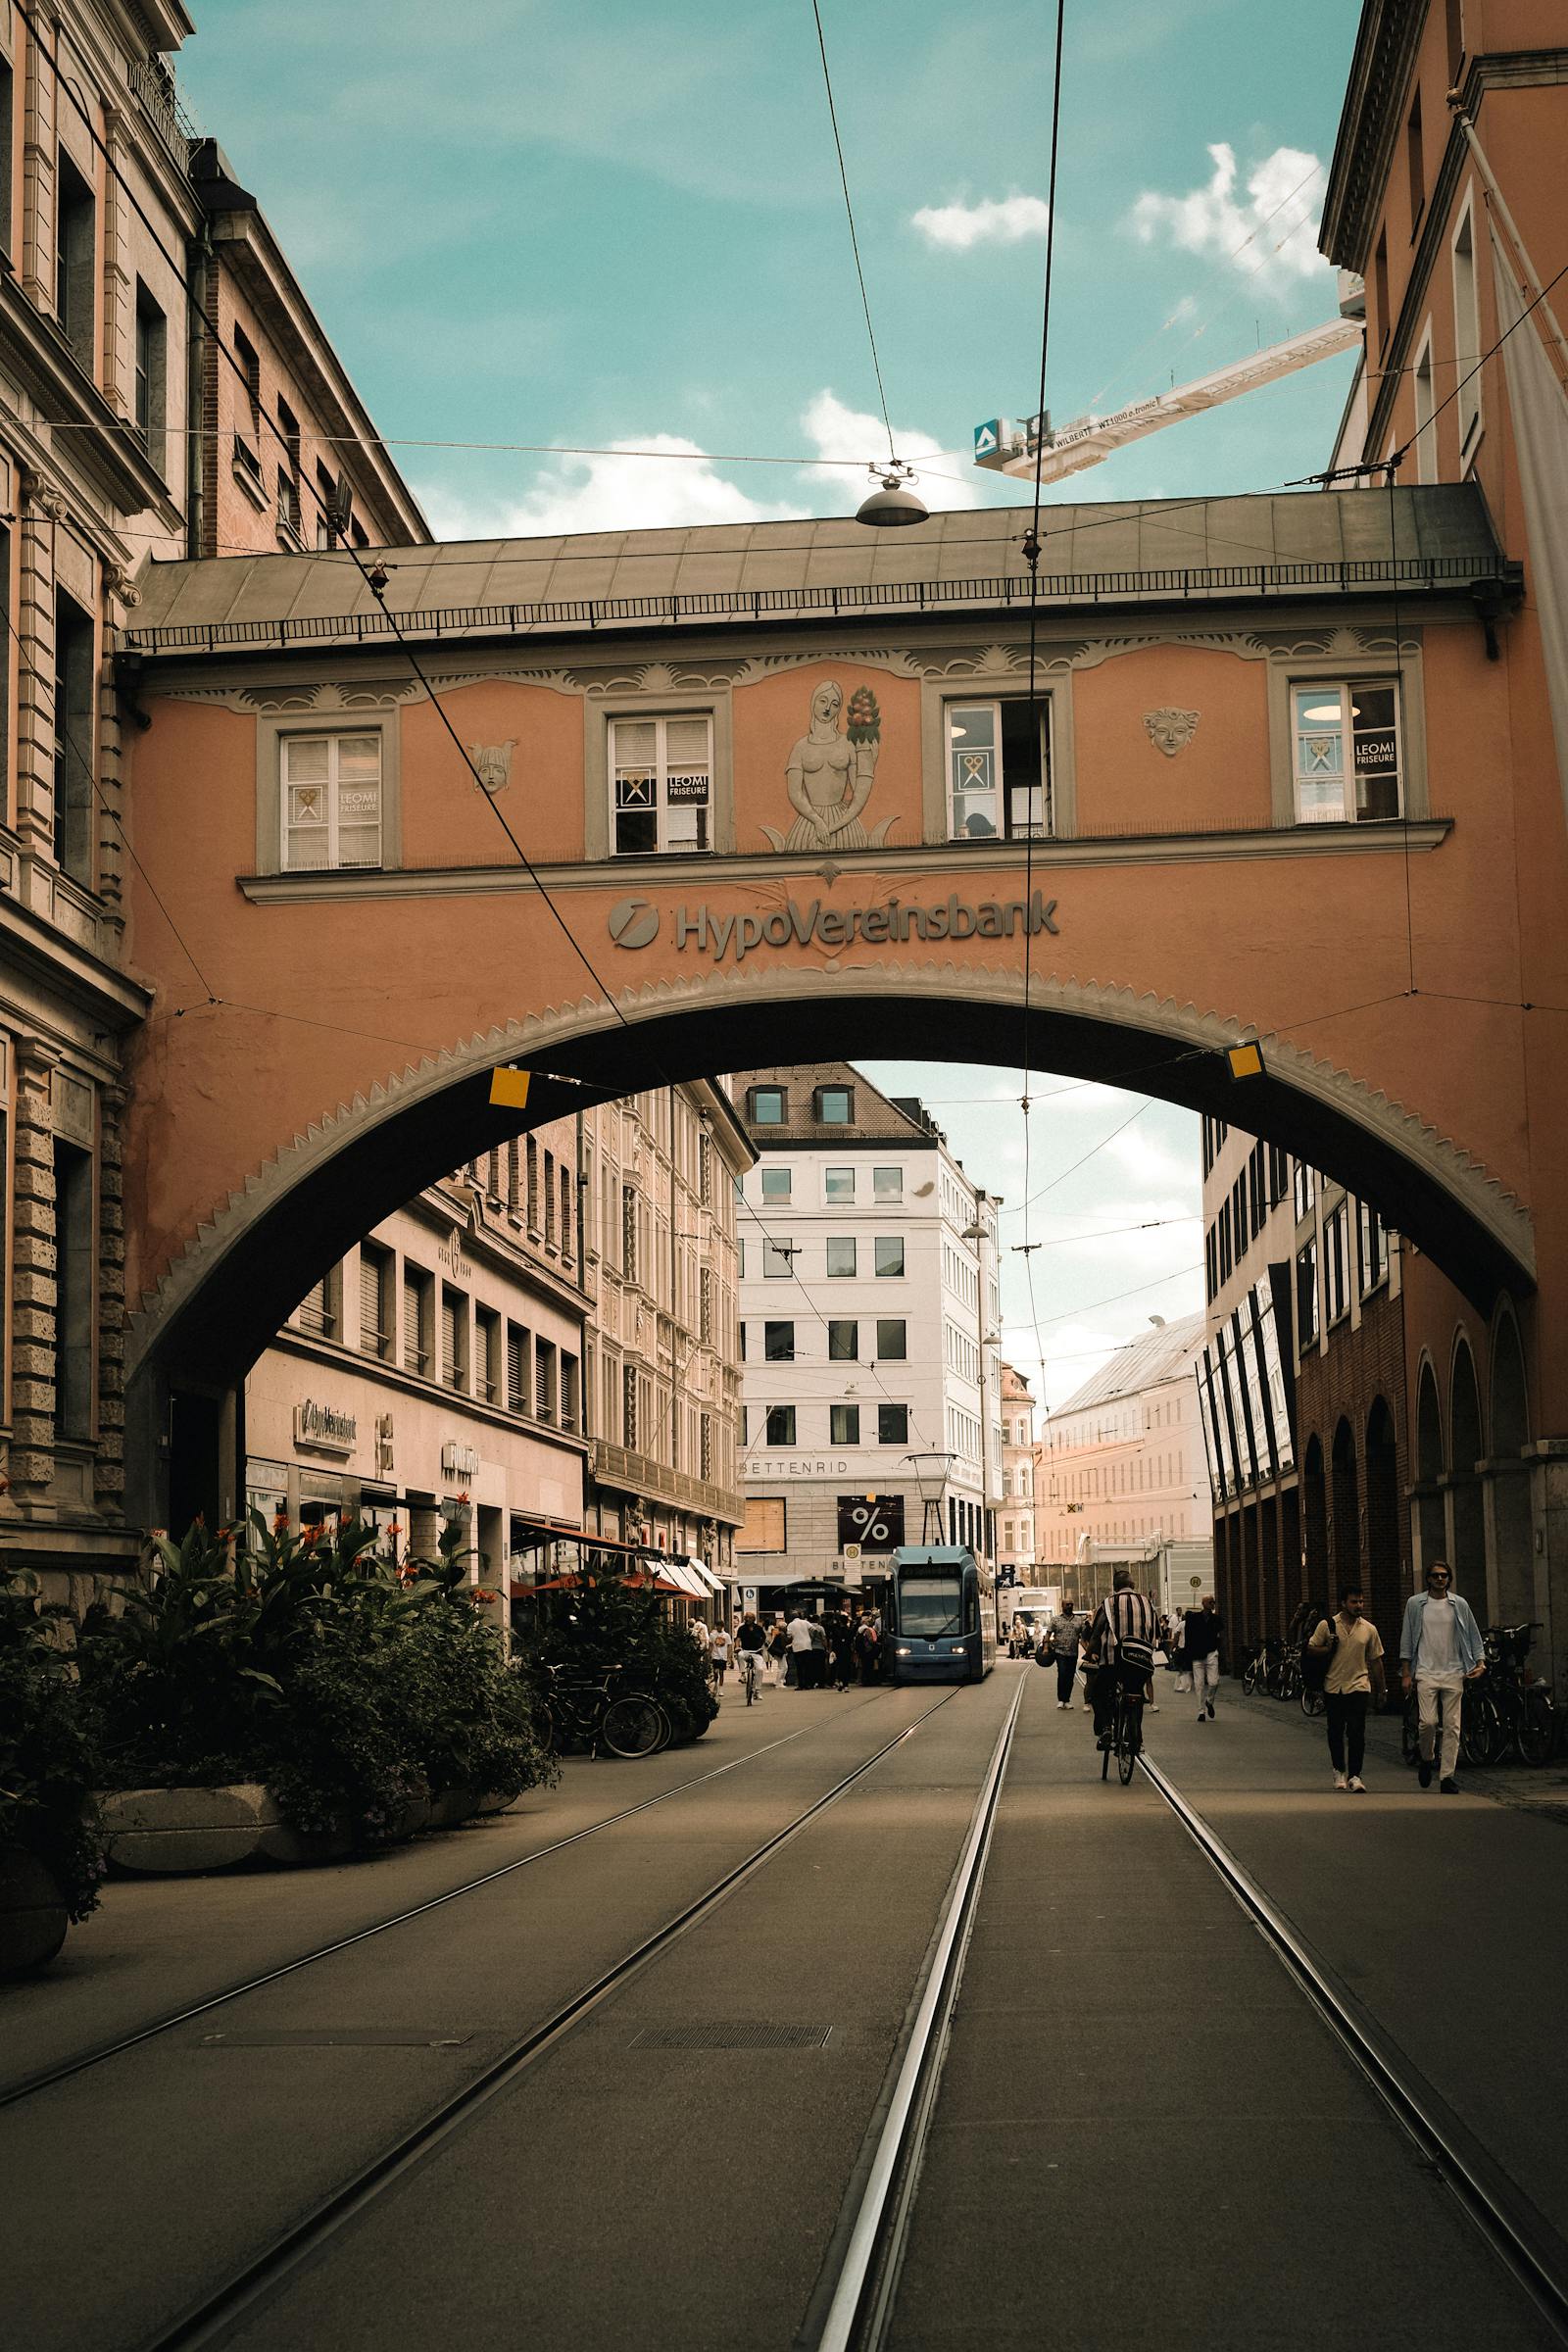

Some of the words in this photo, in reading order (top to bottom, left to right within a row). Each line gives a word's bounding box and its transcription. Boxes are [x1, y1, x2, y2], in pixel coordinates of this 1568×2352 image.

[1055, 428, 1090, 448] WILBERT
[1356, 742, 1395, 756] LEOMI
[1356, 753, 1395, 764] FRISEURE
[669, 775, 707, 787] LEOMI
[669, 786, 708, 796] FRISEURE
[340, 792, 376, 804] LEOMI
[340, 804, 377, 812] FRISEURE
[676, 889, 1060, 961] HypoVereinsbank
[739, 1461, 848, 1474] BETTENRID
[832, 1560, 886, 1570] BTEN
